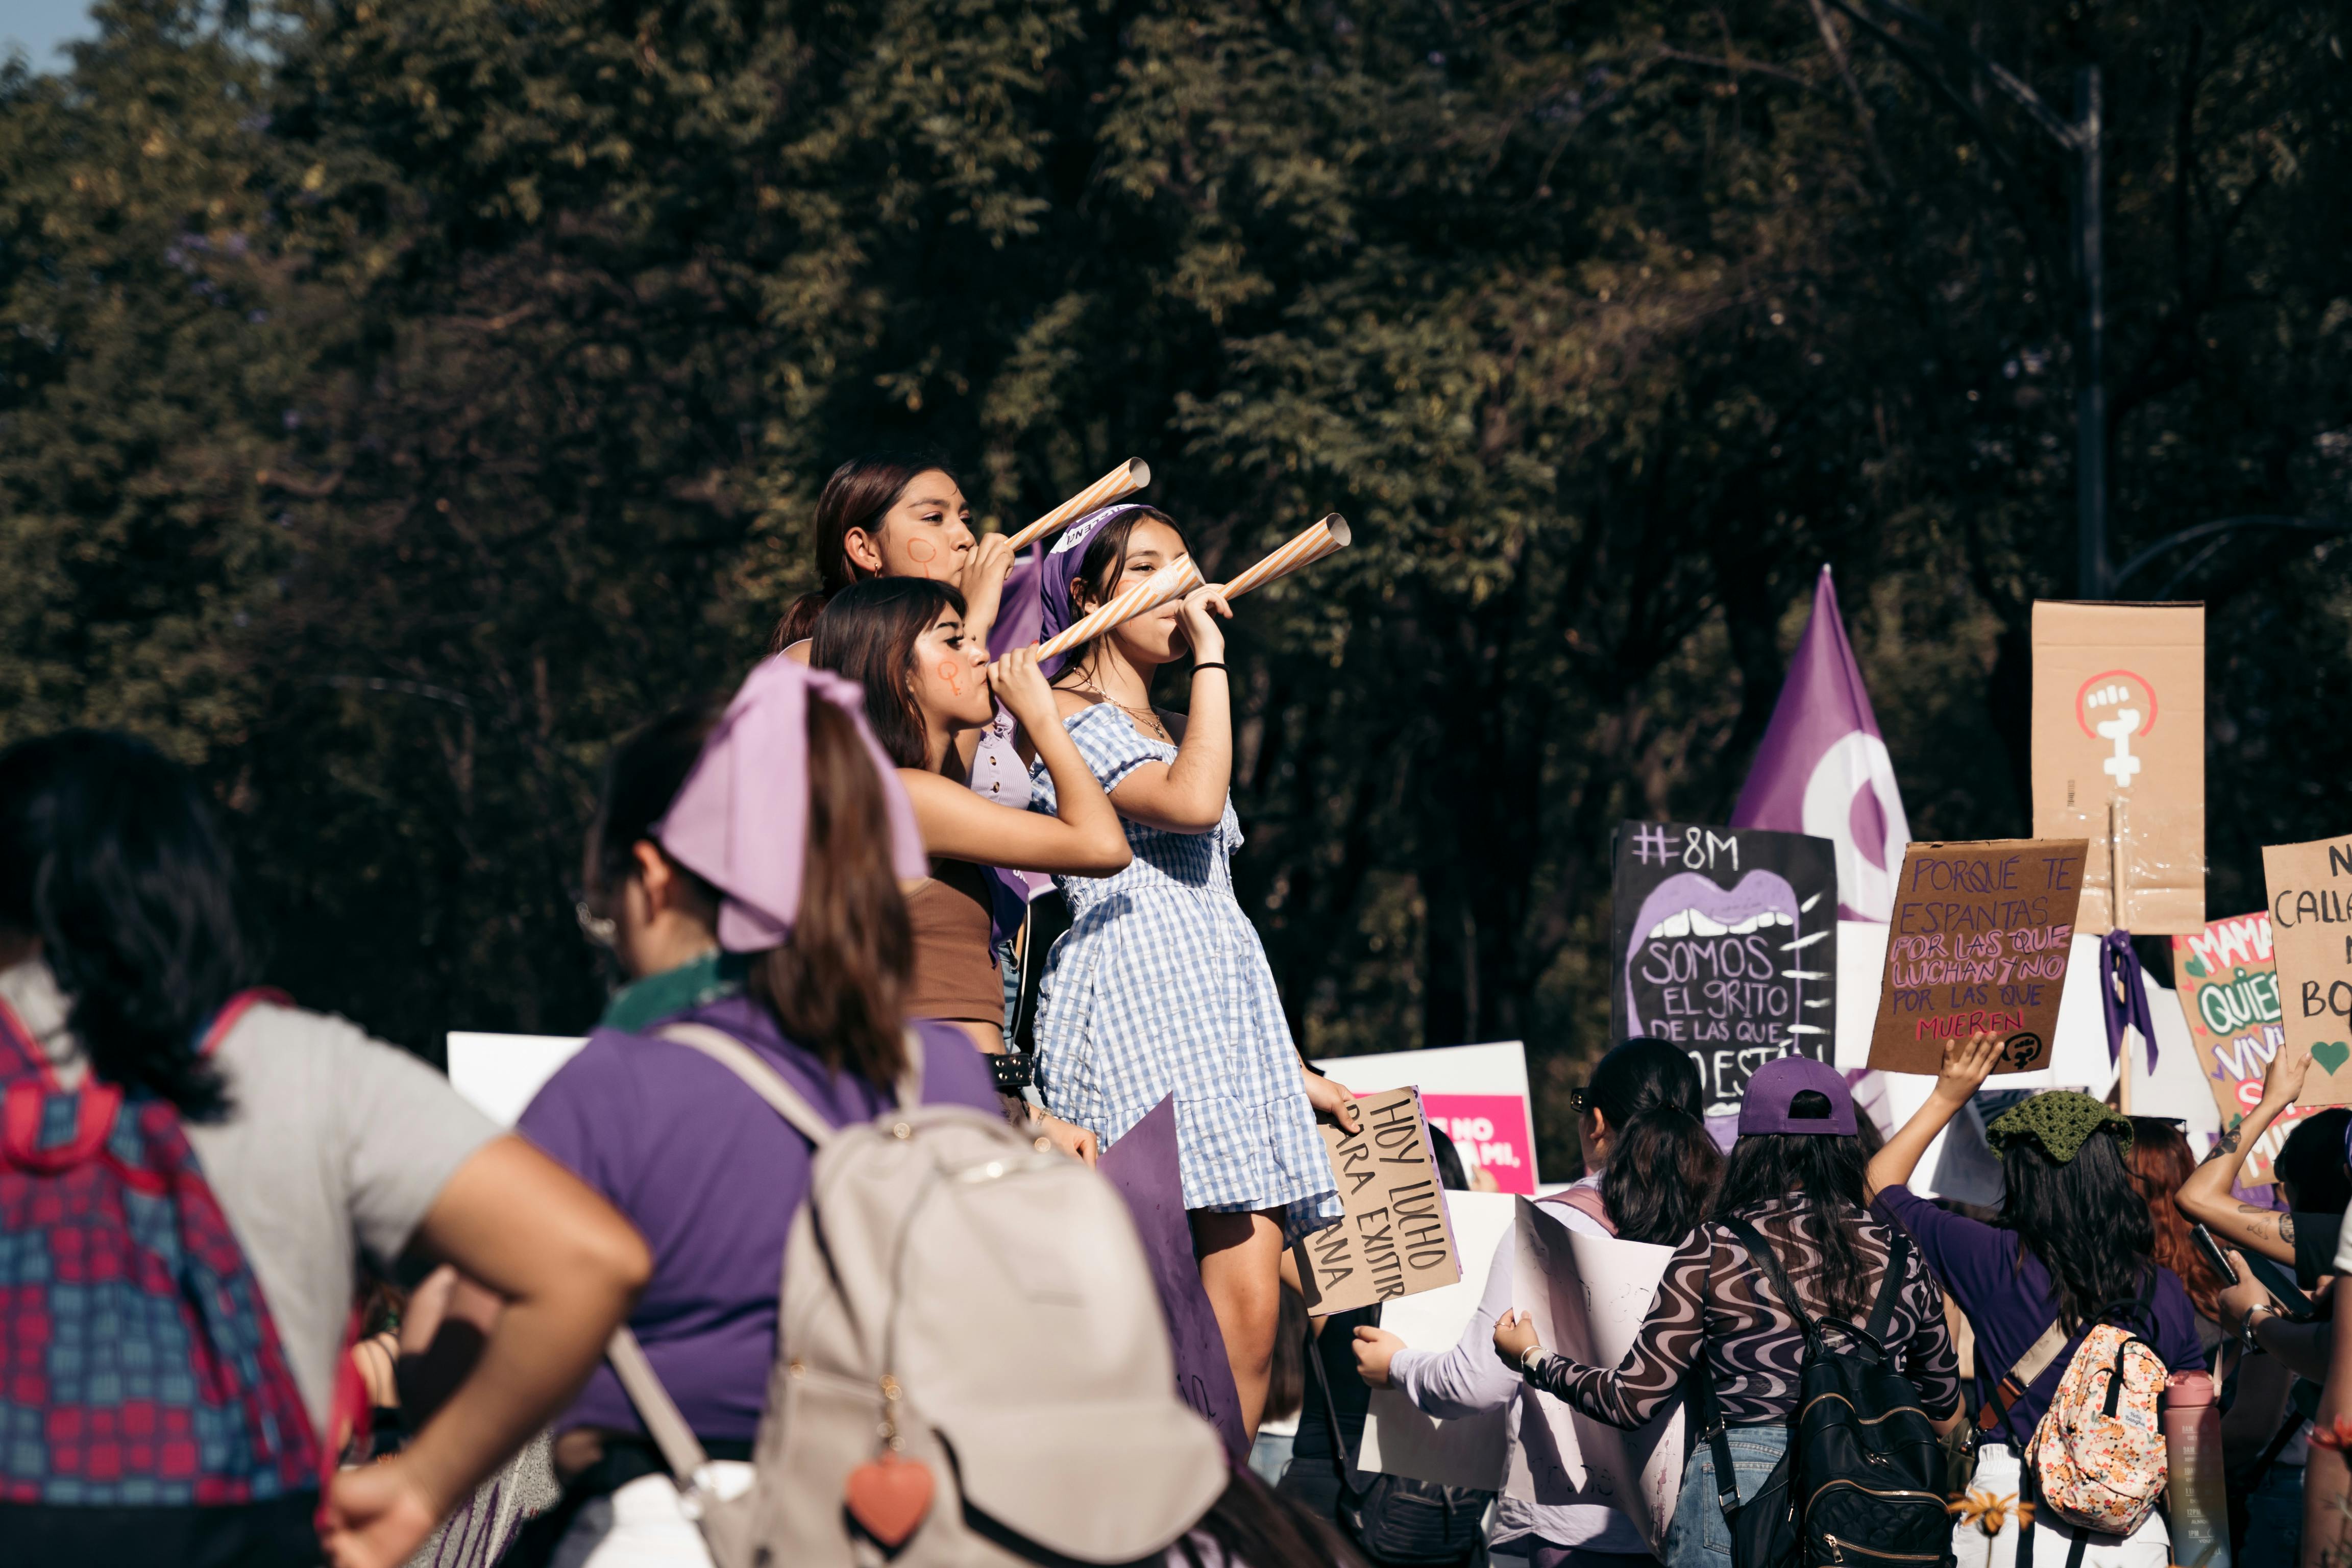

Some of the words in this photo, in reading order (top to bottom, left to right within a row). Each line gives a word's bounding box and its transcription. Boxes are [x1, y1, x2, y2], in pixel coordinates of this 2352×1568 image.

[1632, 823, 1738, 871] #8M
[1912, 854, 2020, 893] PORQUÉ
[2042, 857, 2078, 891] TE
[1900, 896, 2048, 934] ESPANTAS
[1643, 935, 1773, 984] SOMOS
[1891, 934, 1948, 961] POR
[1955, 928, 2002, 960] LAS
[2007, 923, 2071, 955] QUE
[1892, 959, 1997, 987] LUCHAN
[2019, 953, 2065, 981] NO
[1663, 987, 1703, 1015] EL
[1893, 988, 1934, 1015] POR
[1951, 985, 1988, 1009] LAS
[2000, 984, 2045, 1007] QUE
[1651, 1019, 1686, 1041] DE
[1694, 1020, 1730, 1041] LAS
[1736, 1021, 1784, 1043] QUE
[1917, 1008, 2025, 1041] MUEREN
[1370, 1098, 1425, 1164] HOY
[1451, 1117, 1494, 1141] NO
[1389, 1180, 1447, 1270] LUCHO
[1314, 1220, 1354, 1291] ANA
[1356, 1207, 1405, 1302] EXISTIR
